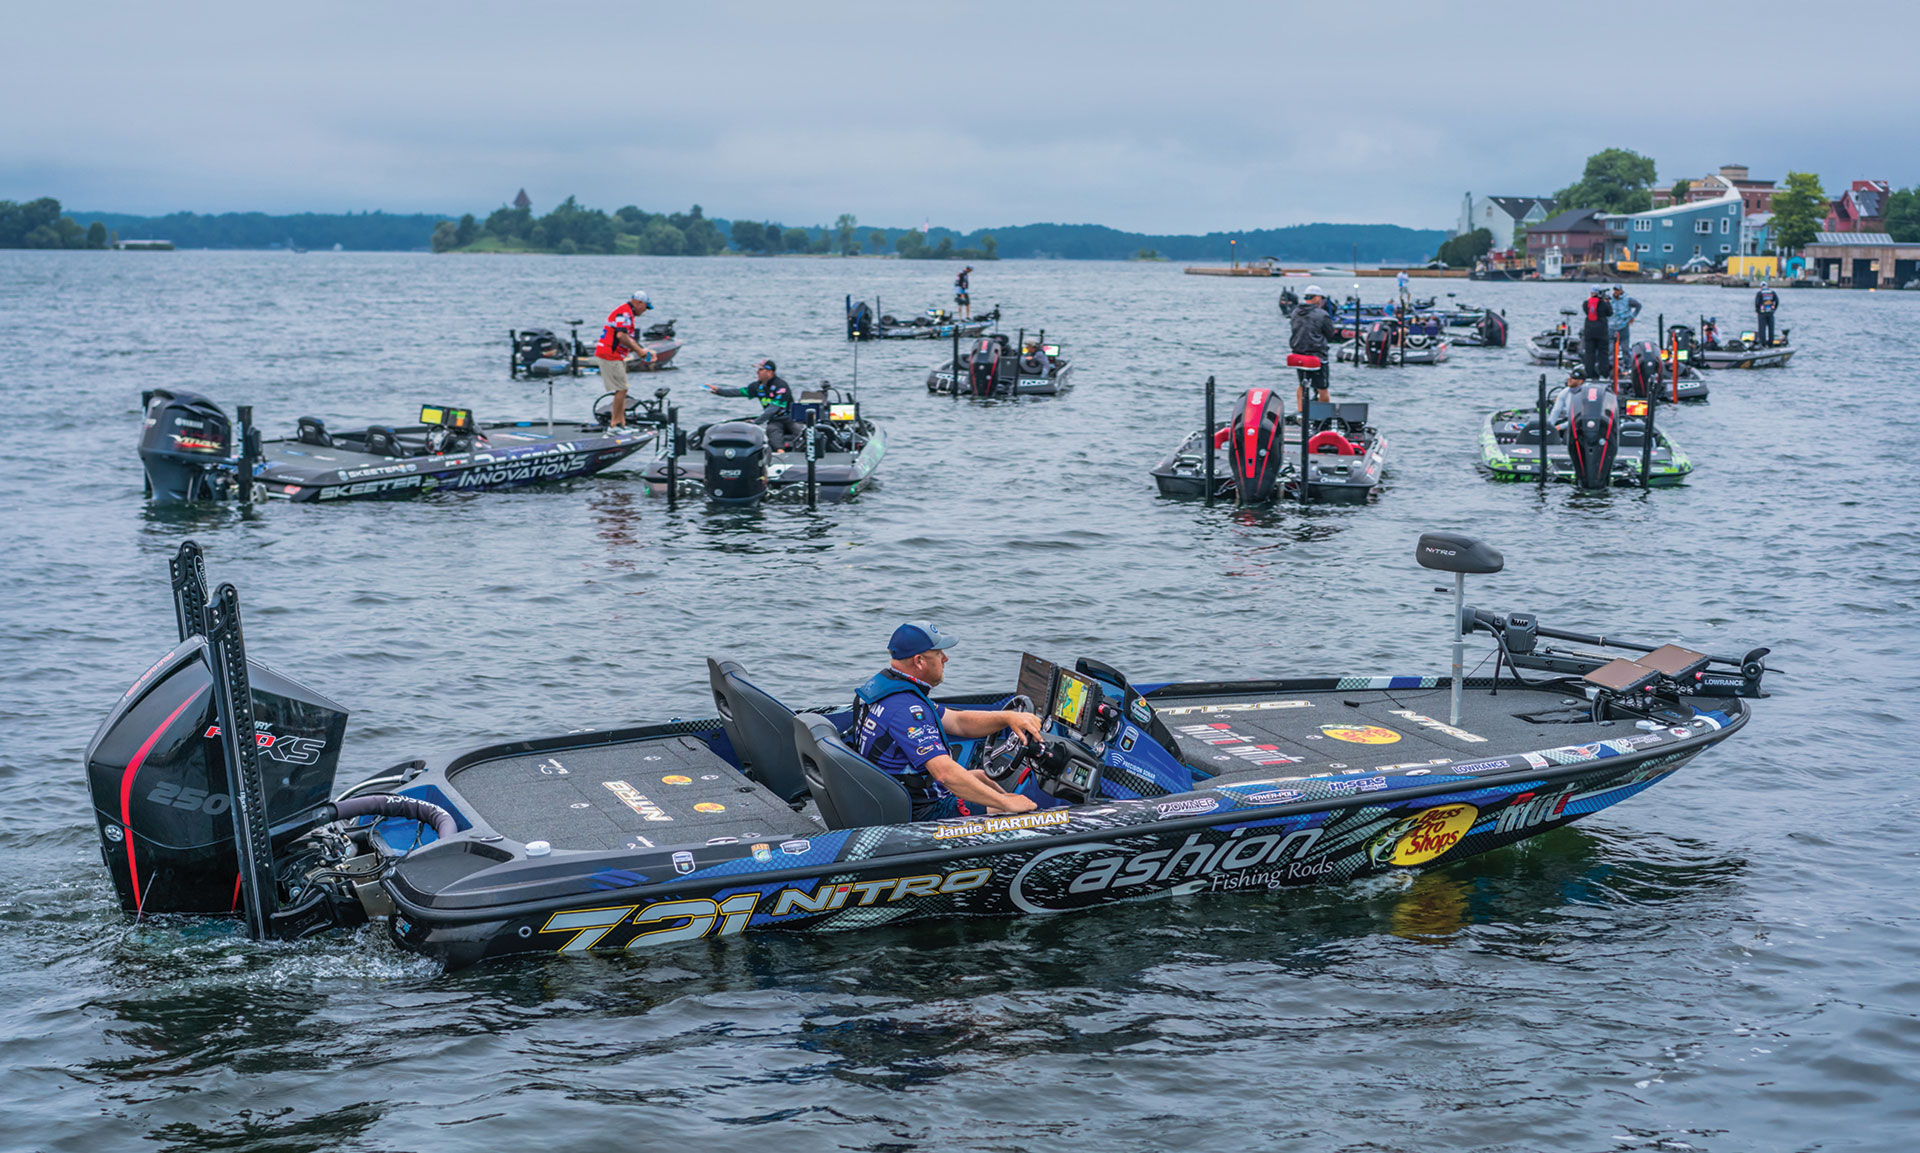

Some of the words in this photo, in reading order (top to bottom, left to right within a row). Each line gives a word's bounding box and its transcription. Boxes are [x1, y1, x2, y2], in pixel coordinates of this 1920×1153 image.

[806, 426, 816, 462] TALON
[348, 465, 399, 478] SKEETER
[457, 455, 589, 487] INNOVATIONS
[319, 475, 422, 500] SKEETER
[1425, 547, 1457, 556] NITRO
[1704, 679, 1744, 687] LOWRANCE
[1451, 760, 1511, 775] LOWRANCE
[1250, 790, 1298, 801] POWER-POLE
[1329, 776, 1386, 791] HI-SEAS
[147, 781, 231, 815] 250
[1171, 799, 1216, 811] OWNER
[934, 823, 984, 839] Jamie
[985, 811, 1069, 832] HARTMAN
[1419, 806, 1464, 823] Bass
[1414, 820, 1446, 838] Pro
[1405, 830, 1460, 855] Shops
[1009, 827, 1325, 914] Cashion
[1211, 866, 1281, 892] Fishing
[1287, 856, 1334, 880] Rods
[772, 868, 993, 916] NITRO
[539, 893, 761, 952] 721
